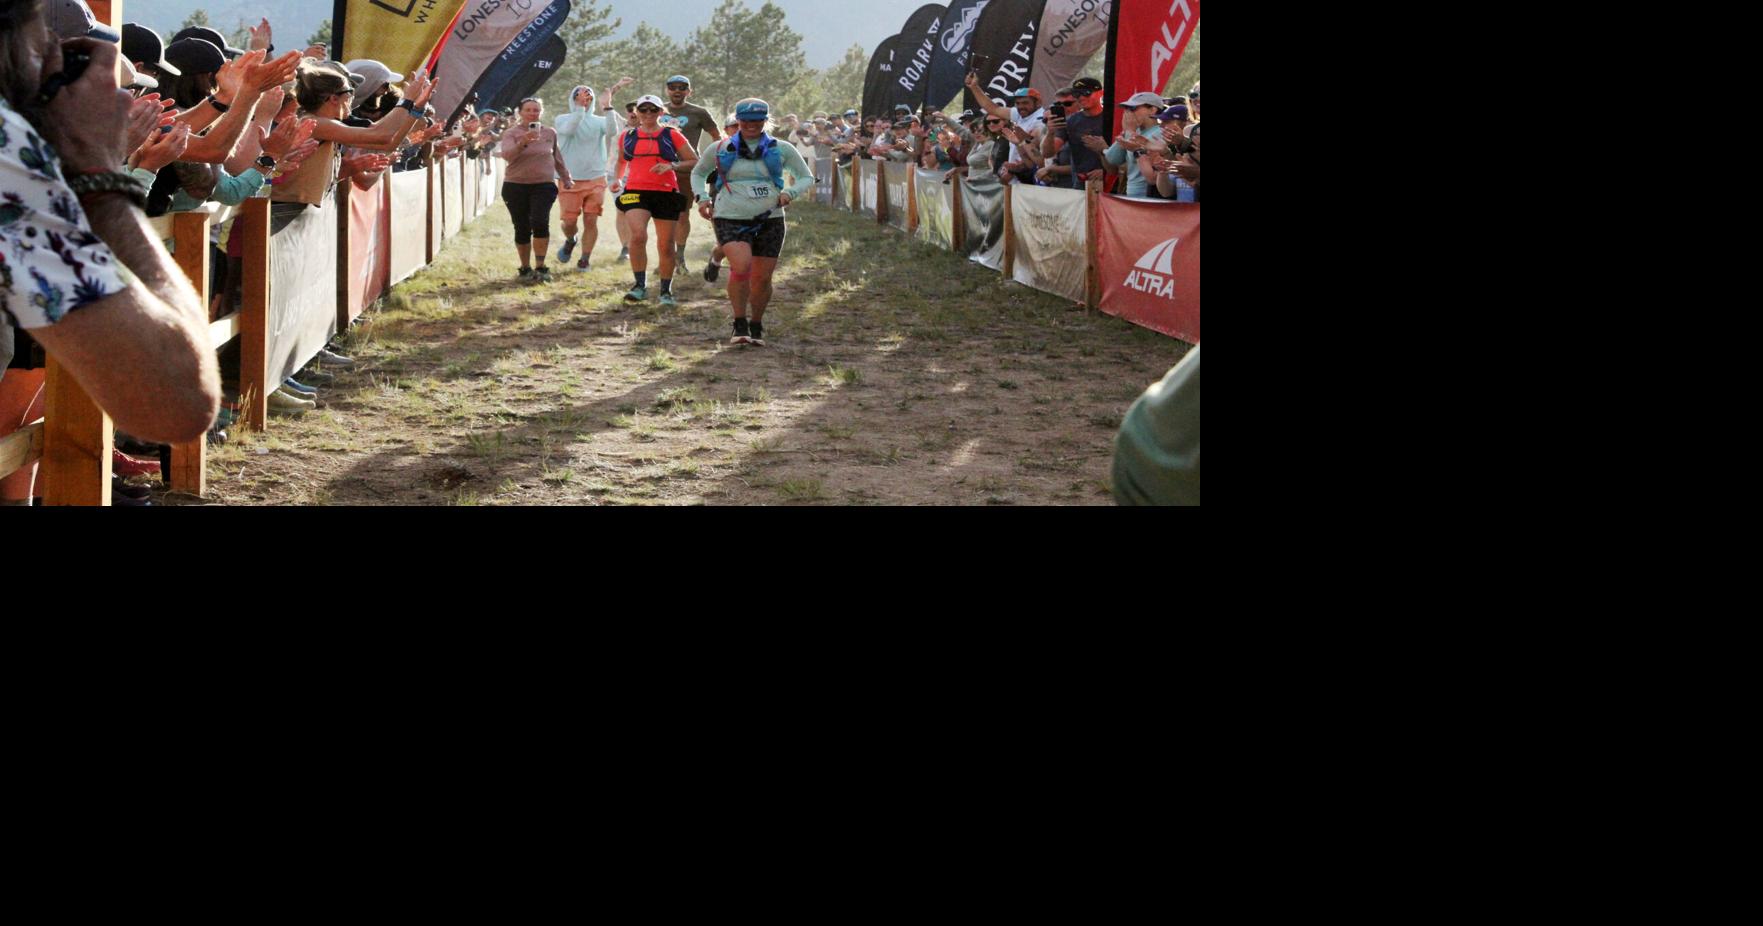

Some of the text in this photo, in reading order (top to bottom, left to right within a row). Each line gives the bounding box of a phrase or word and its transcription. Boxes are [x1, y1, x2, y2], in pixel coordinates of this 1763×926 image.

[899, 38, 933, 92] ROARK
[751, 186, 769, 196] 105
[1123, 270, 1175, 300] ALTRA
